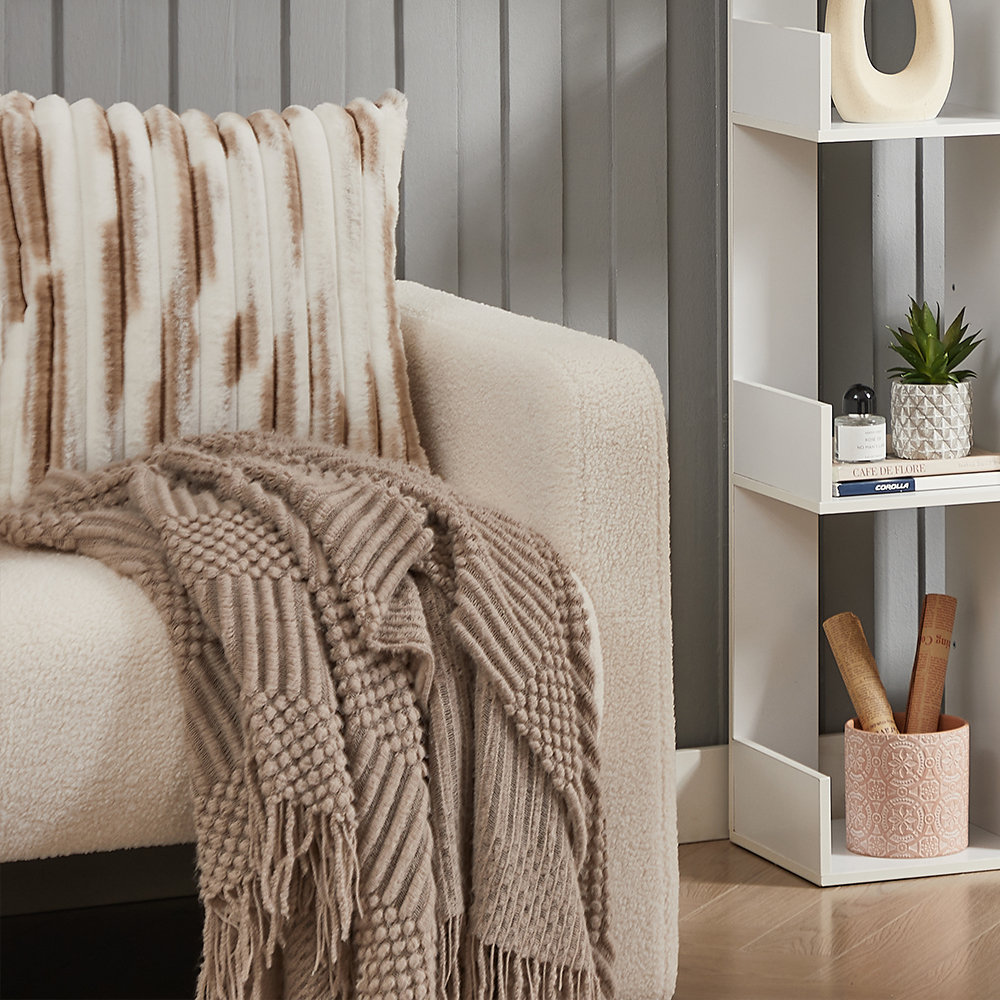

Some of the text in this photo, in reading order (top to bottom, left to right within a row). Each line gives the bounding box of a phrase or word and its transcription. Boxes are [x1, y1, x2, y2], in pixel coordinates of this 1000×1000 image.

[852, 463, 927, 478] CAFE DE FLORE
[874, 481, 910, 491] COROLLA
